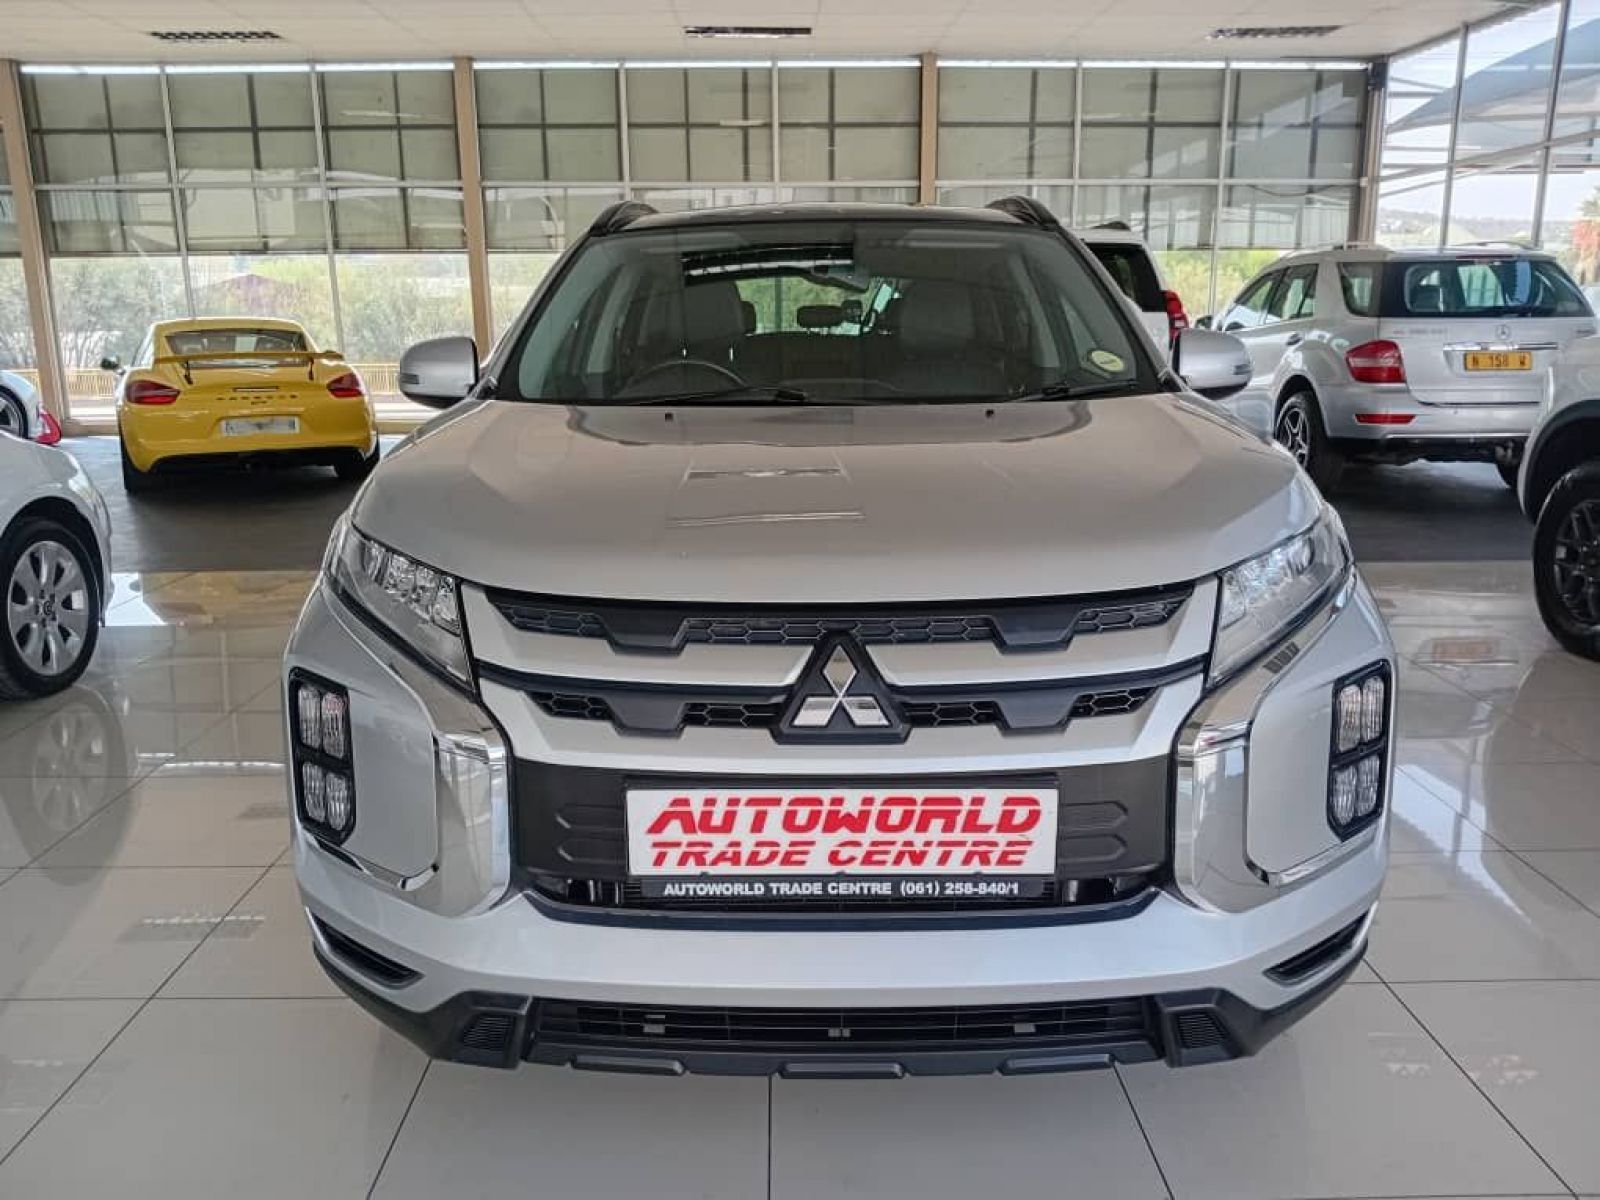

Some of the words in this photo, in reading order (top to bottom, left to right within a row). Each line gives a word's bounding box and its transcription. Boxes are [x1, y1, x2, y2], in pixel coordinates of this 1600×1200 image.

[646, 795, 1042, 835] AUTOWORLD
[651, 840, 816, 867] TRADE
[828, 840, 1033, 867] CENTRE
[664, 882, 764, 896] AUTOWORLD
[769, 882, 823, 896] TRADE
[828, 882, 892, 895] CENTRE
[901, 880, 940, 897] (061)
